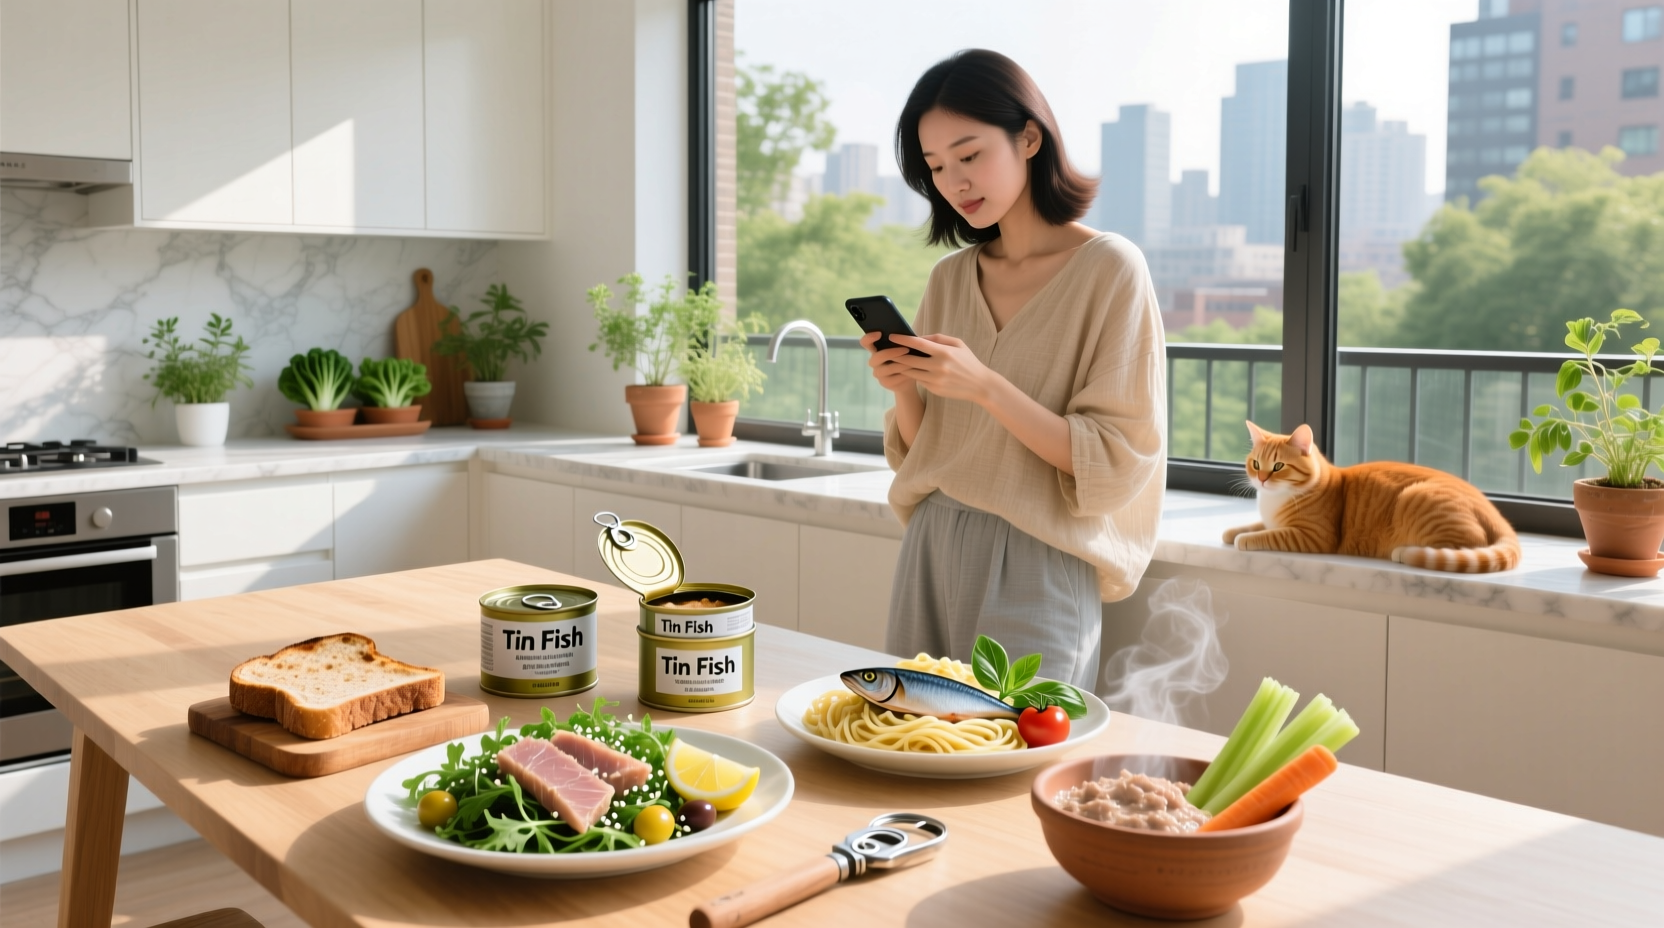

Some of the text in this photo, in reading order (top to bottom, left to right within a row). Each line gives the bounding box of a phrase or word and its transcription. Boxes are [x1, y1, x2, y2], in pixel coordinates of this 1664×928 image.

[685, 620, 714, 634] Fish
[502, 629, 535, 651] Tin
[541, 625, 583, 651] Fish
[661, 655, 735, 676] Tin Fish
